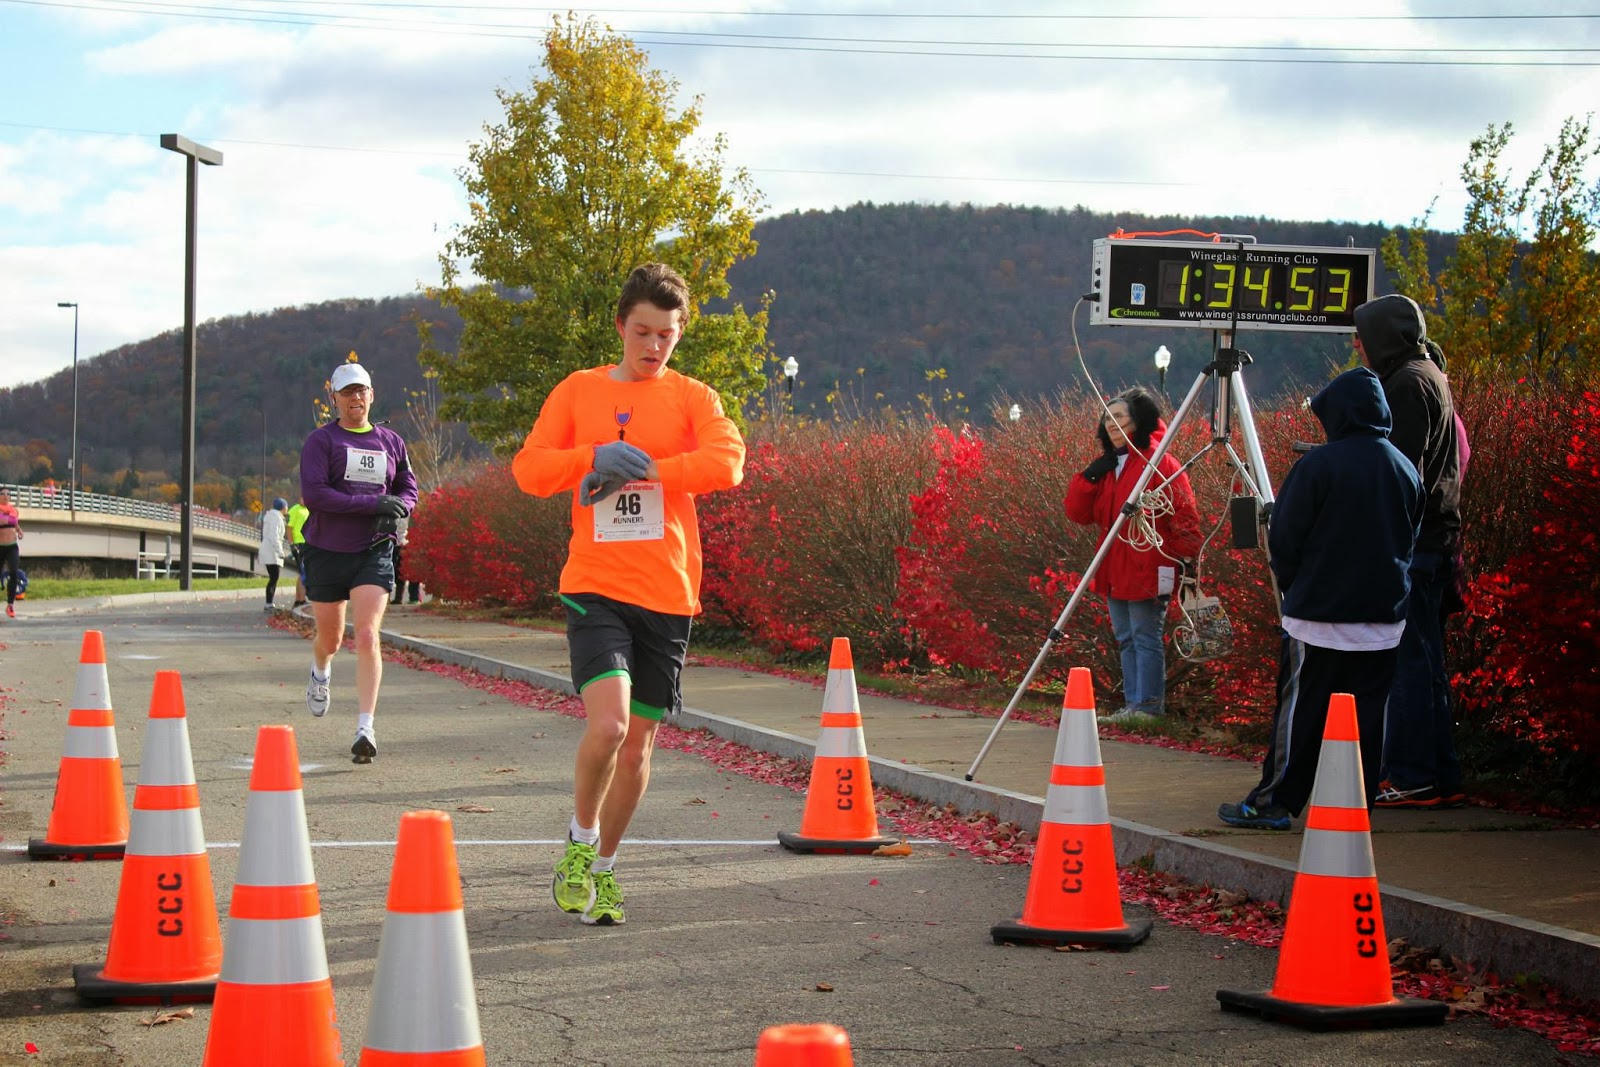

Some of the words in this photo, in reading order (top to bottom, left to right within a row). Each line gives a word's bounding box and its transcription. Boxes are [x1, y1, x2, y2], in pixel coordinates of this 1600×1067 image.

[1246, 253, 1290, 265] Running
[1294, 255, 1319, 265] Club
[1178, 264, 1351, 312] 1:34.53
[1123, 309, 1160, 317] chronomix
[360, 455, 374, 468] 48
[615, 493, 641, 516] 46
[836, 768, 853, 811] CCC
[1061, 839, 1084, 894] CCC
[157, 872, 183, 937] CCC
[1353, 892, 1378, 959] CCC
